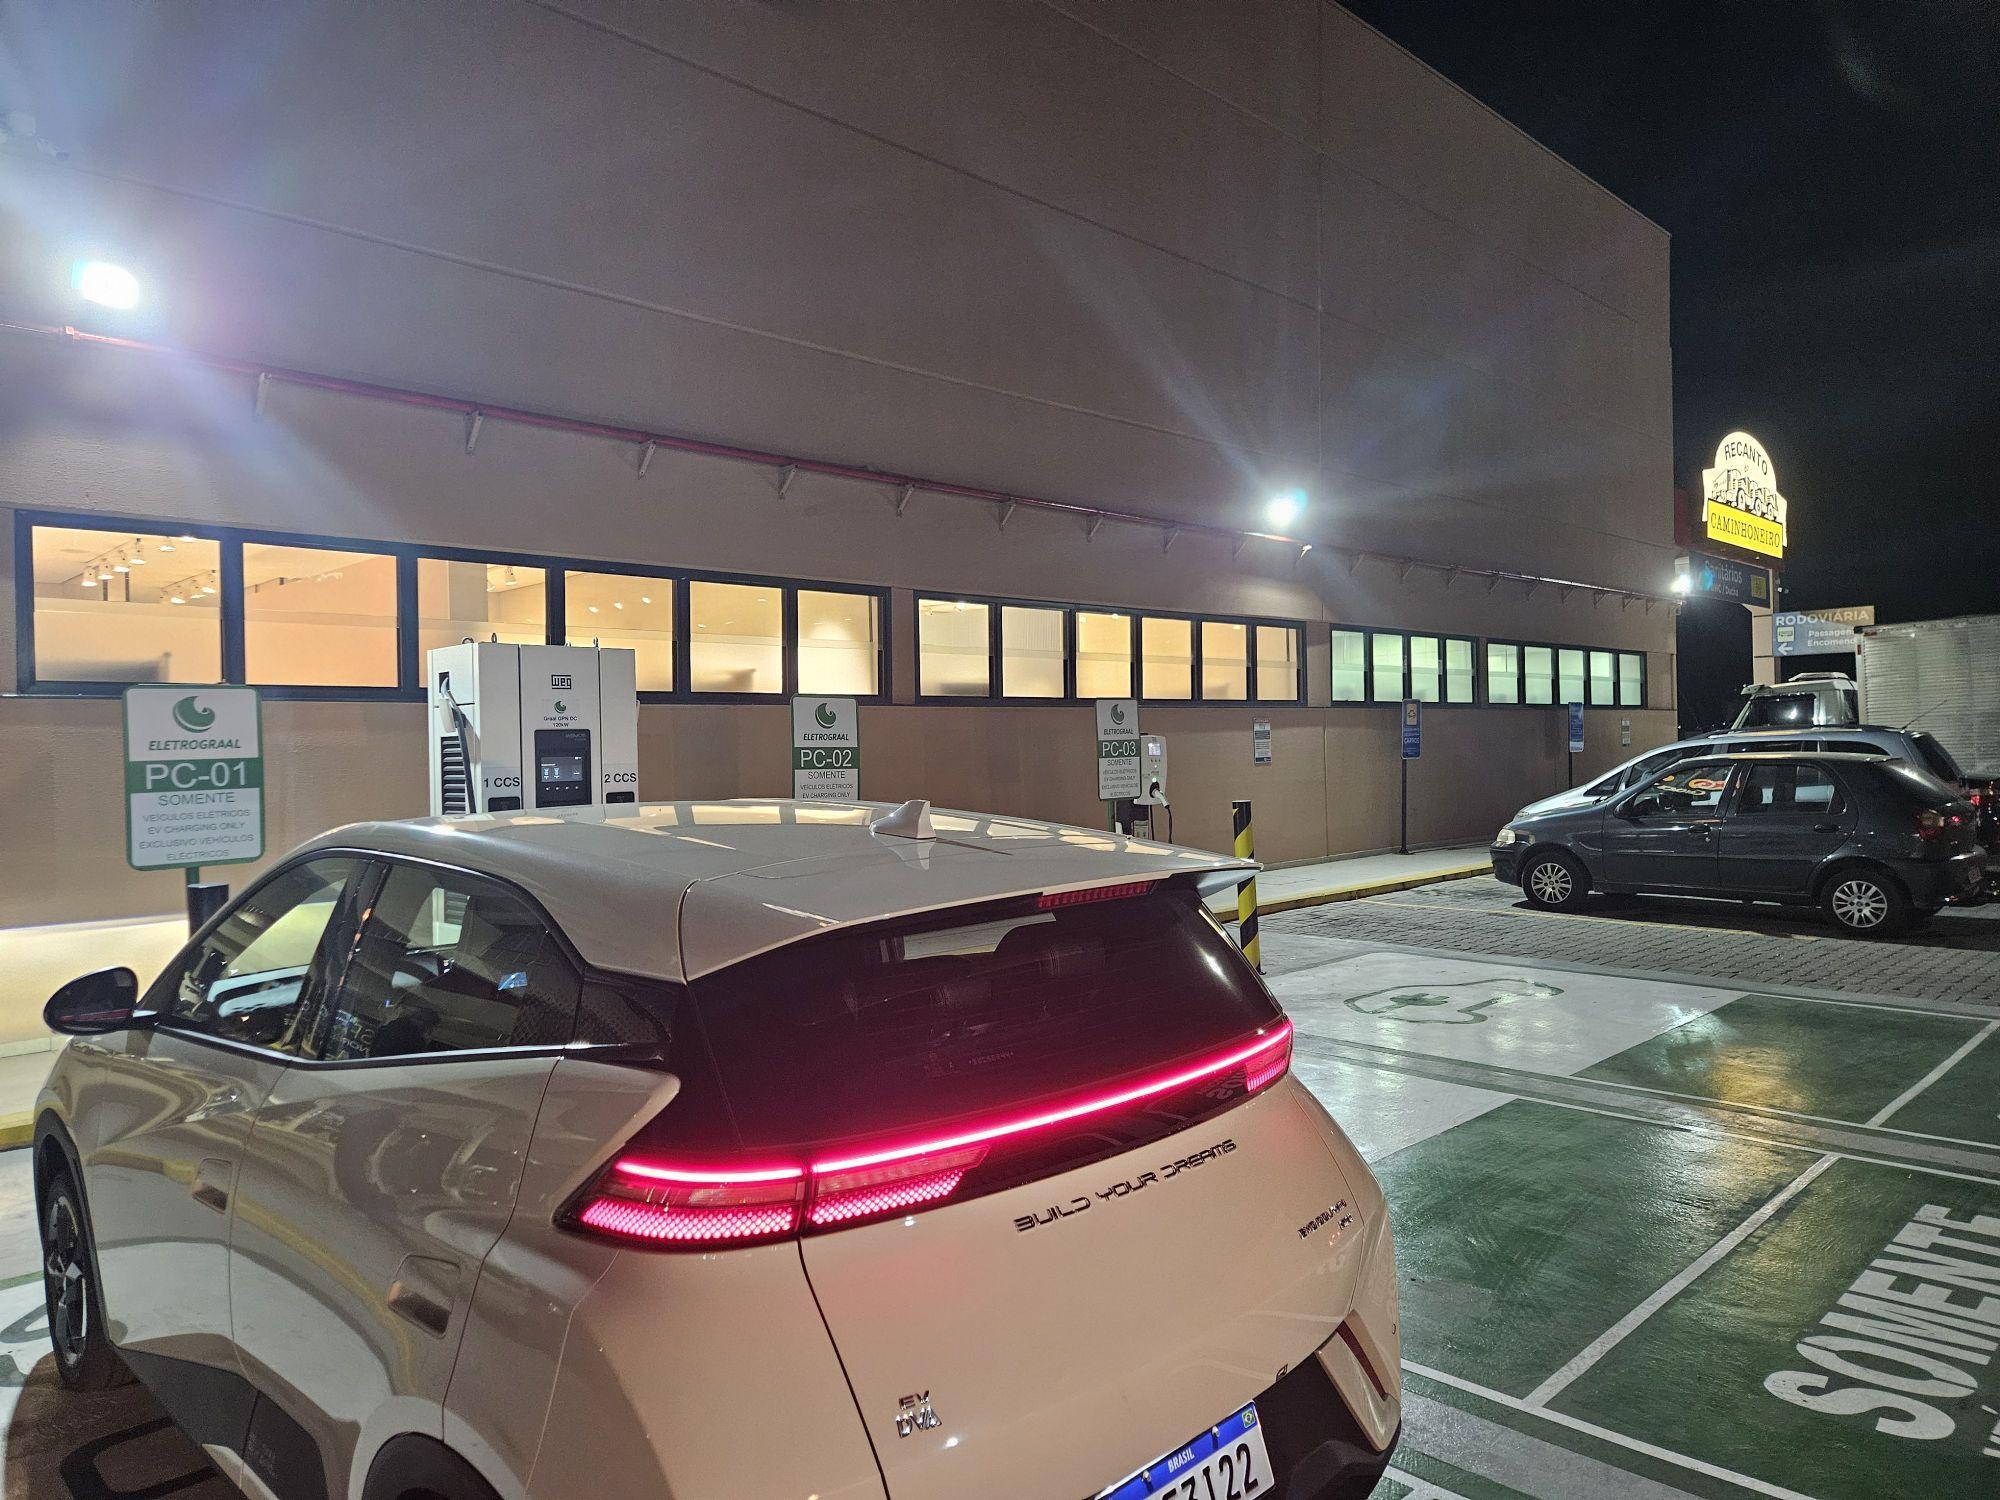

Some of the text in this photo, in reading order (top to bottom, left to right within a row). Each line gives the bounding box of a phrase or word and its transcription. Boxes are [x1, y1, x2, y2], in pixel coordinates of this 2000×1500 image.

[1724, 441, 1768, 475] RECANTO
[1710, 513, 1780, 548] CAMINHONEIRO
[1776, 608, 1869, 626] RODOVIÁRIA
[803, 733, 849, 741] ELETROGRAAL
[148, 739, 241, 751] ELETROGRAAL
[1102, 741, 1137, 757] PC-03
[800, 749, 852, 767] PC-02
[1107, 758, 1132, 766] SOMENTE
[145, 761, 247, 790] PC-01
[604, 773, 637, 783] 2 CCS
[808, 770, 846, 779] SOMENTE
[484, 777, 520, 788] 1 CCS
[158, 792, 236, 807] SOMENTE
[147, 821, 246, 835] EV CHARGING ONLY
[139, 837, 197, 850] EXCLUSIVO
[1013, 1139, 1237, 1232] BUILD YOUR DREAMS
[899, 1390, 930, 1410] EV
[1167, 1447, 1195, 1473] BRASIL
